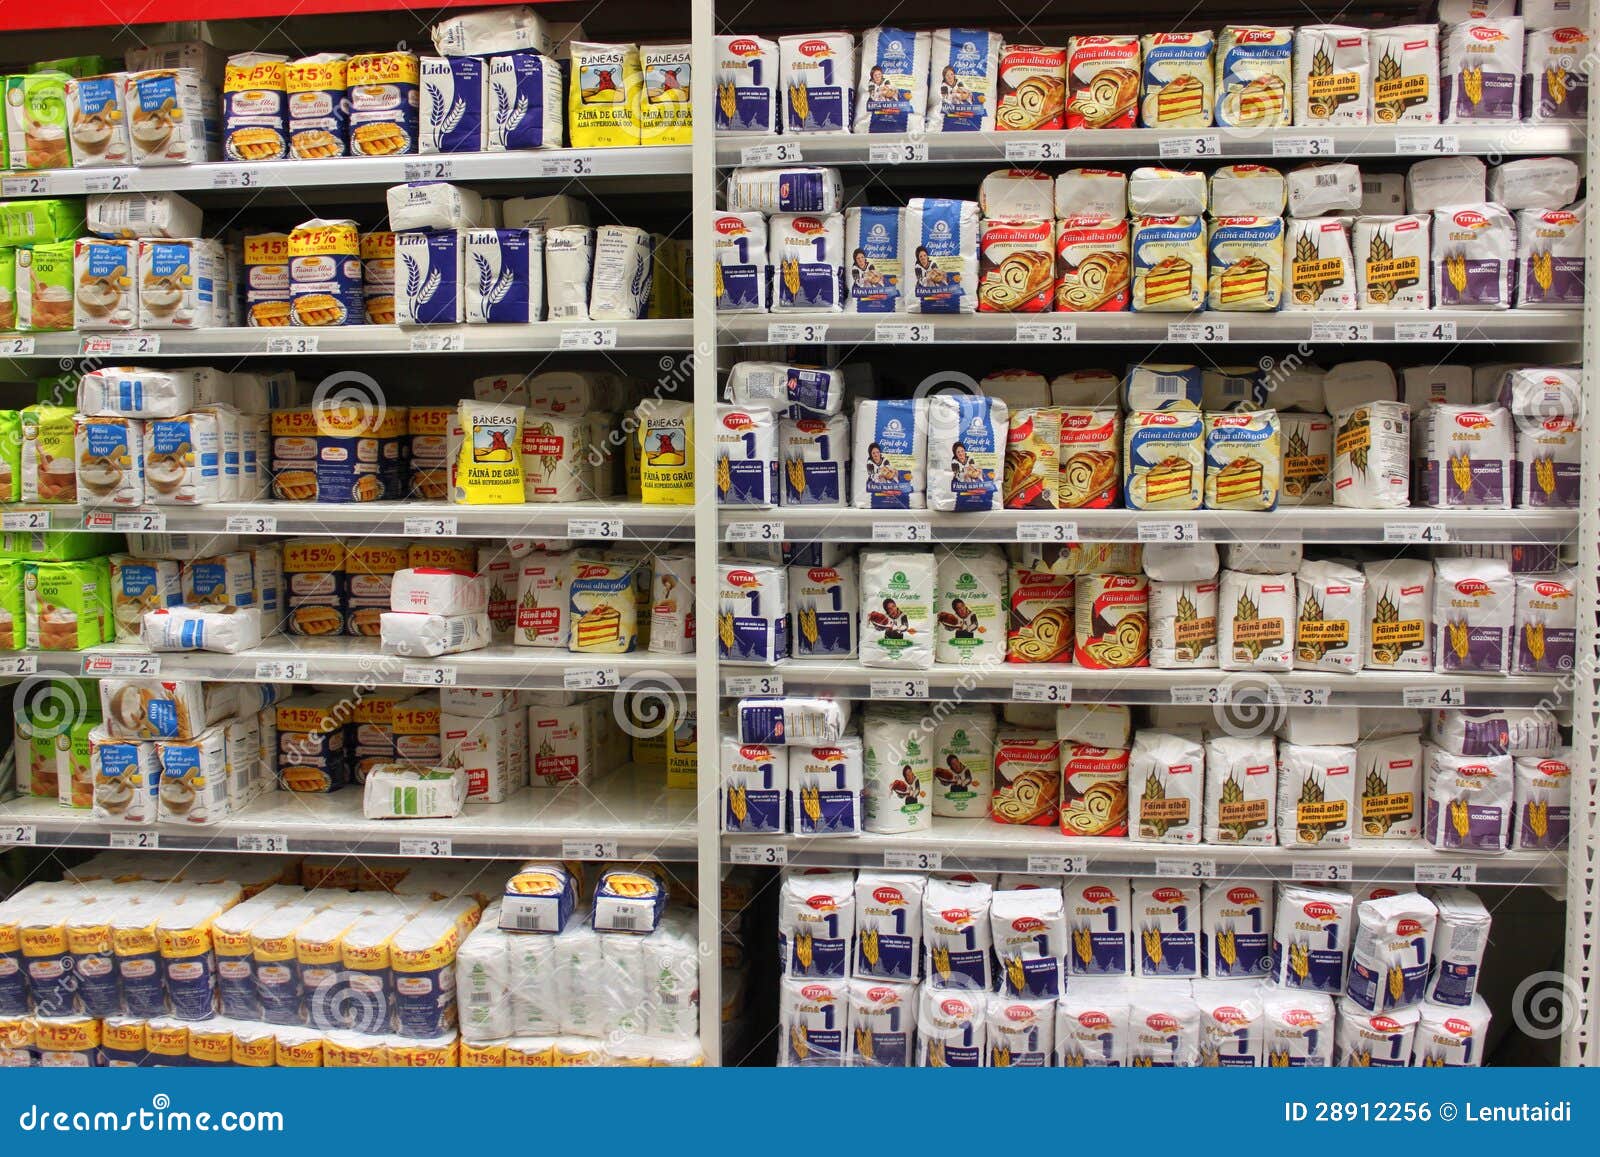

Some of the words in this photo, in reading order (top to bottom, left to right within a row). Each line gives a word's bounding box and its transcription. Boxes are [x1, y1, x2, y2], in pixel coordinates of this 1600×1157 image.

[1250, 32, 1272, 40] spice
[1476, 30, 1498, 38] TITAN
[422, 64, 450, 75] Lido
[490, 62, 512, 74] Lido
[748, 59, 762, 85] 1
[818, 59, 834, 85] 1
[777, 146, 786, 160] 3
[905, 146, 915, 160] 3
[1196, 139, 1206, 153] 3
[435, 164, 444, 177] 2
[573, 159, 583, 173] 3
[720, 222, 742, 230] TITAN
[400, 236, 426, 246] Lido
[469, 234, 497, 245] Lido
[734, 237, 748, 263] 1
[812, 237, 826, 262] 1
[1297, 262, 1320, 273] Făină
[1322, 260, 1340, 269] albă
[804, 327, 814, 341] 3
[911, 327, 920, 341] 3
[1205, 326, 1215, 340] 3
[1433, 325, 1443, 339] 4
[275, 414, 316, 426] +15%
[1139, 413, 1153, 425] 7
[742, 432, 756, 459] 1
[814, 435, 830, 460] 1
[30, 514, 37, 527] 2
[436, 521, 444, 534] 3
[601, 522, 609, 536] 3
[1174, 526, 1184, 540] 3
[1422, 527, 1432, 541] 4
[290, 549, 336, 561] +15%
[412, 551, 456, 563] +15%
[746, 591, 759, 616] 1
[827, 586, 841, 611] 1
[1237, 622, 1259, 631] Făină
[1262, 621, 1280, 629] albă
[1301, 622, 1325, 632] Făină
[1326, 621, 1345, 631] albă
[597, 672, 606, 685] 3
[761, 679, 770, 693] 3
[905, 682, 915, 696] 3
[1441, 690, 1451, 704] 4
[758, 763, 774, 789] 1
[831, 763, 845, 789] 1
[1327, 803, 1344, 813] albă
[139, 834, 147, 847] 2
[594, 844, 603, 858] 3
[1064, 859, 1073, 873] 3
[1452, 867, 1462, 881] 4
[878, 892, 900, 900] TITAN
[1309, 907, 1333, 915] TITAN
[891, 908, 906, 934] 1
[1103, 906, 1117, 931] 1
[1172, 906, 1188, 931] 1
[1247, 907, 1261, 932] 1
[824, 914, 838, 938] 1
[1324, 923, 1338, 949] 1
[1411, 937, 1426, 964] 1
[38, 1027, 87, 1041] +15%
[107, 1029, 139, 1040] +15%
[1388, 1034, 1403, 1059] 1
[395, 1052, 445, 1066] +15%
